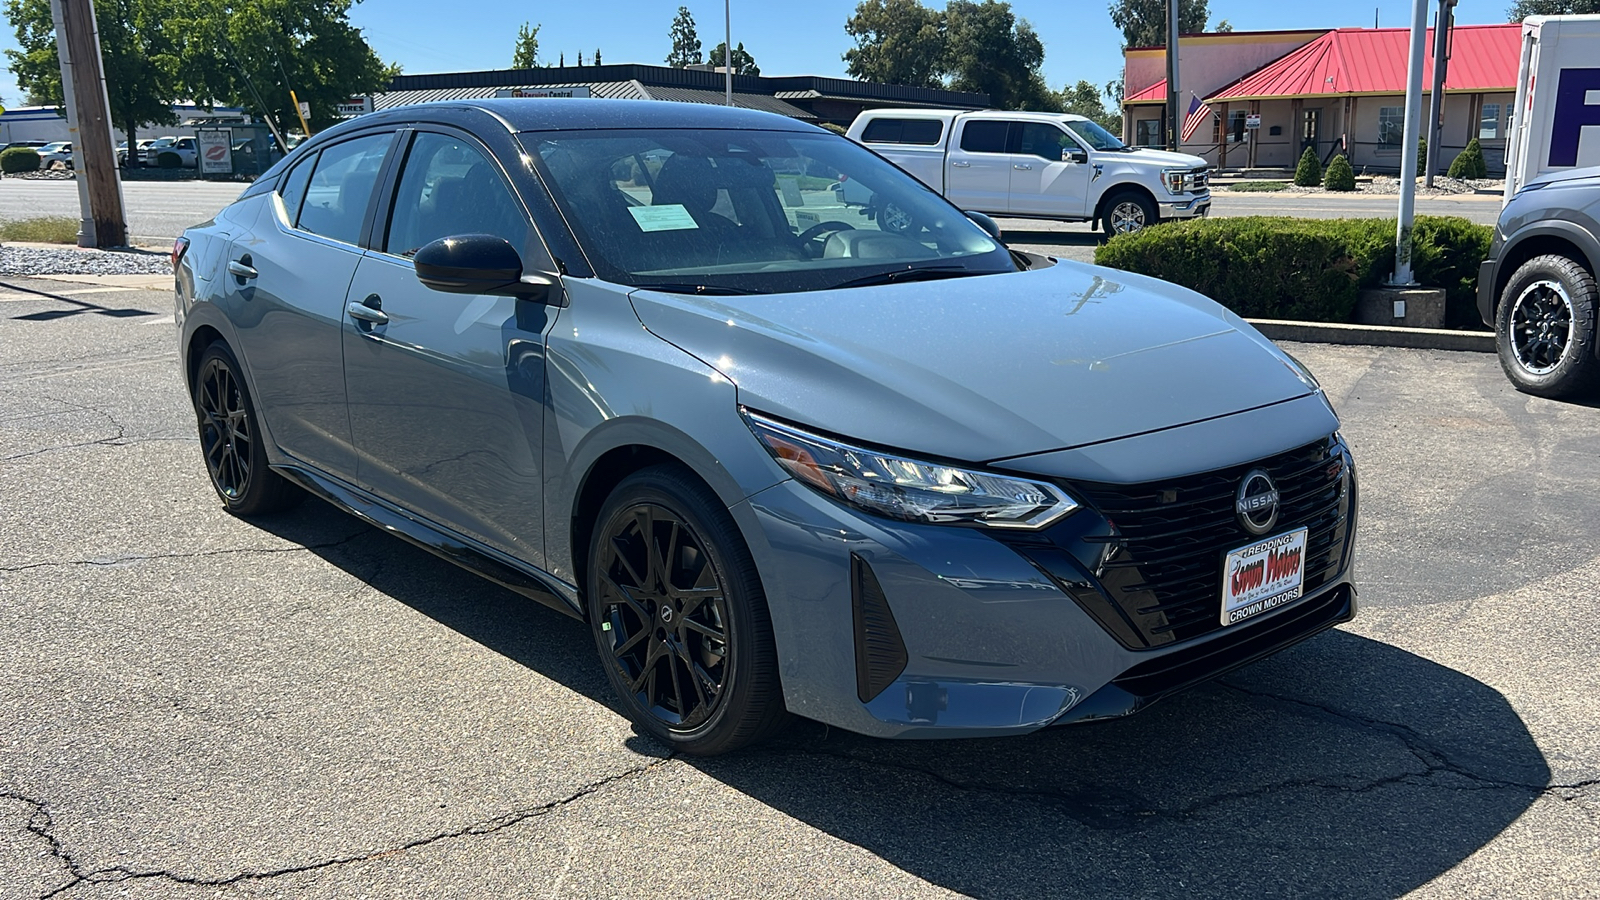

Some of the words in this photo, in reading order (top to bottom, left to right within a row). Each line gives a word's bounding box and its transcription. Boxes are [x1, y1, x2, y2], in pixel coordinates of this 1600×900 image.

[549, 90, 573, 98] Central
[1238, 491, 1278, 511] NISSAN
[1248, 535, 1290, 556] REDDING
[1231, 559, 1264, 597] Crown
[1265, 546, 1301, 585] Motors
[1230, 602, 1262, 622] CROWN
[1263, 588, 1298, 609] MOTORS
